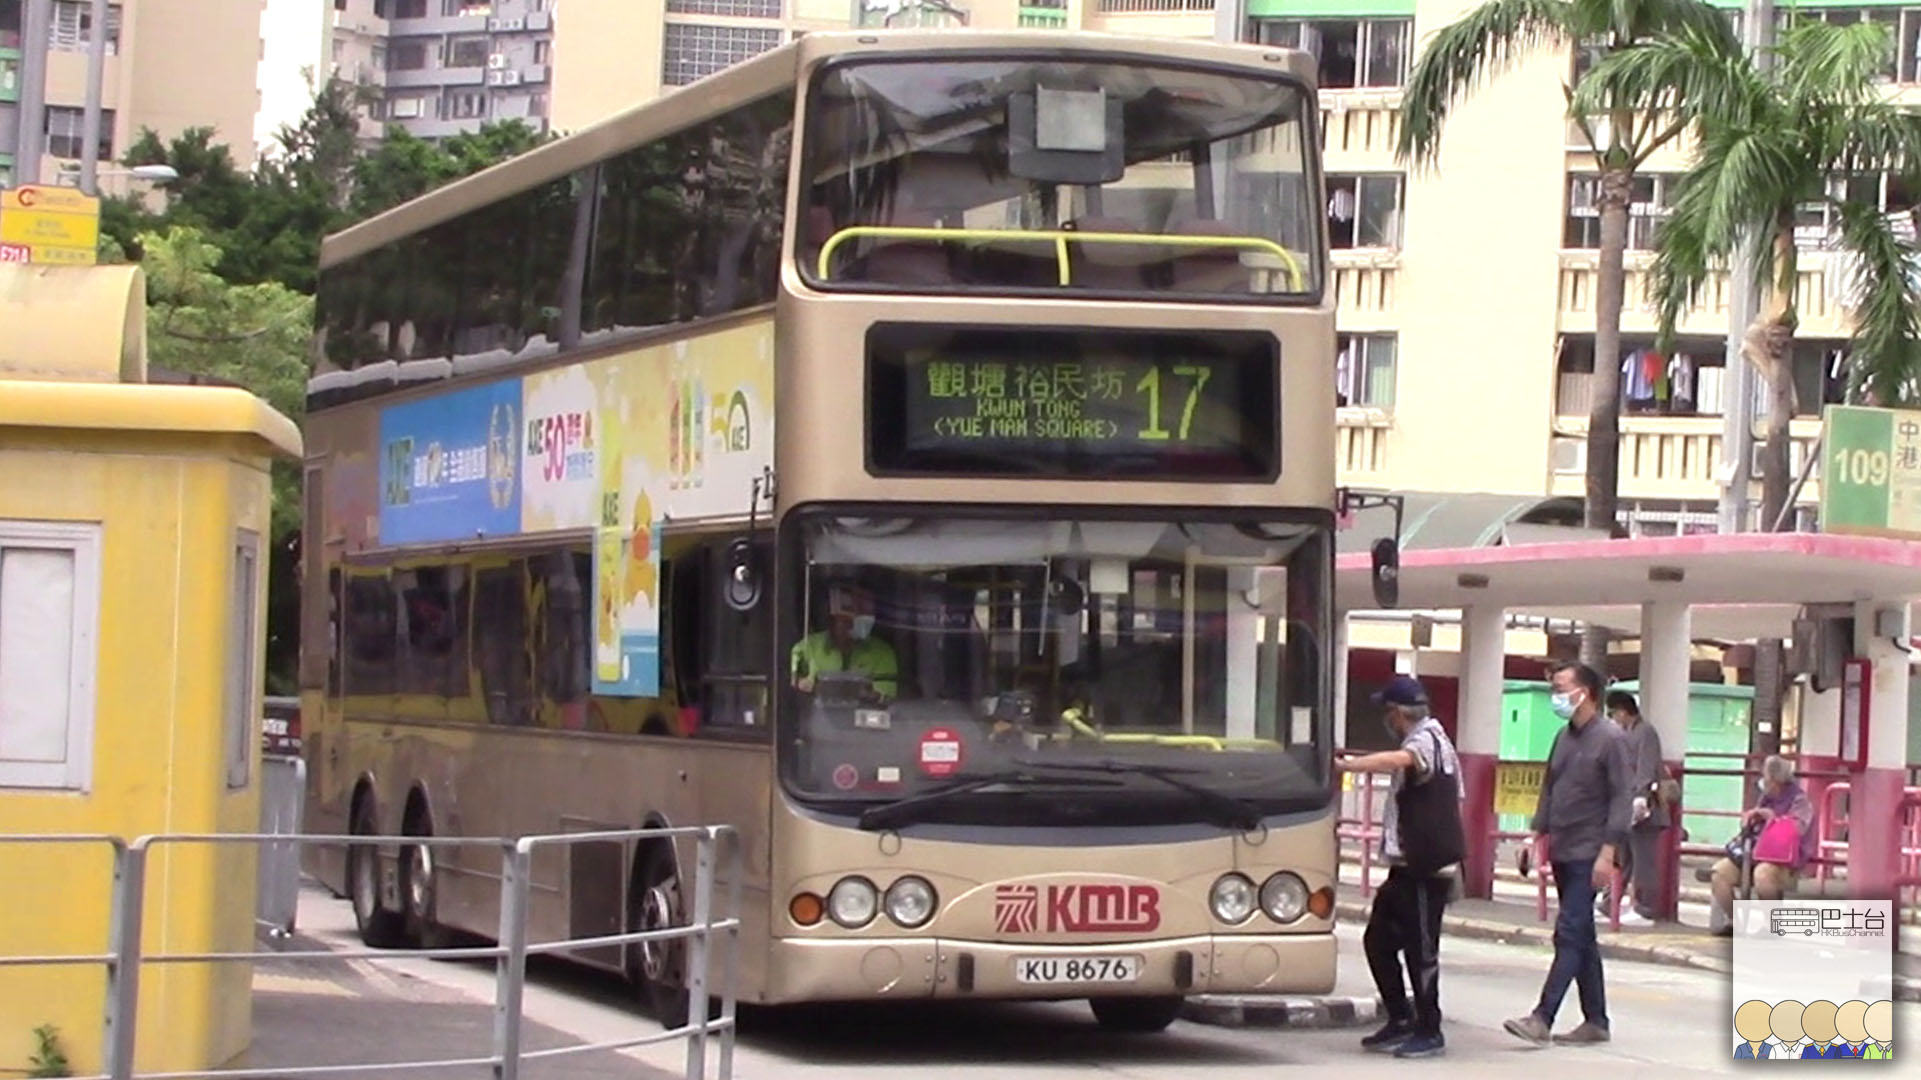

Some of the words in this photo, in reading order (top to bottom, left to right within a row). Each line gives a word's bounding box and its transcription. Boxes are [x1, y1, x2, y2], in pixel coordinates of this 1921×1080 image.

[927, 362, 1127, 399] 觀塘裕民坊
[976, 400, 1025, 418] KWUN
[1034, 400, 1081, 418] TONG
[1136, 365, 1211, 441] 17
[934, 417, 983, 437] (YUE
[990, 418, 1028, 437] MAN
[1035, 420, 1119, 439] SQUARE)
[1835, 447, 1888, 486] 109
[1047, 884, 1161, 932] KMB
[1026, 961, 1058, 981] KU
[1066, 960, 1128, 981] 8676
